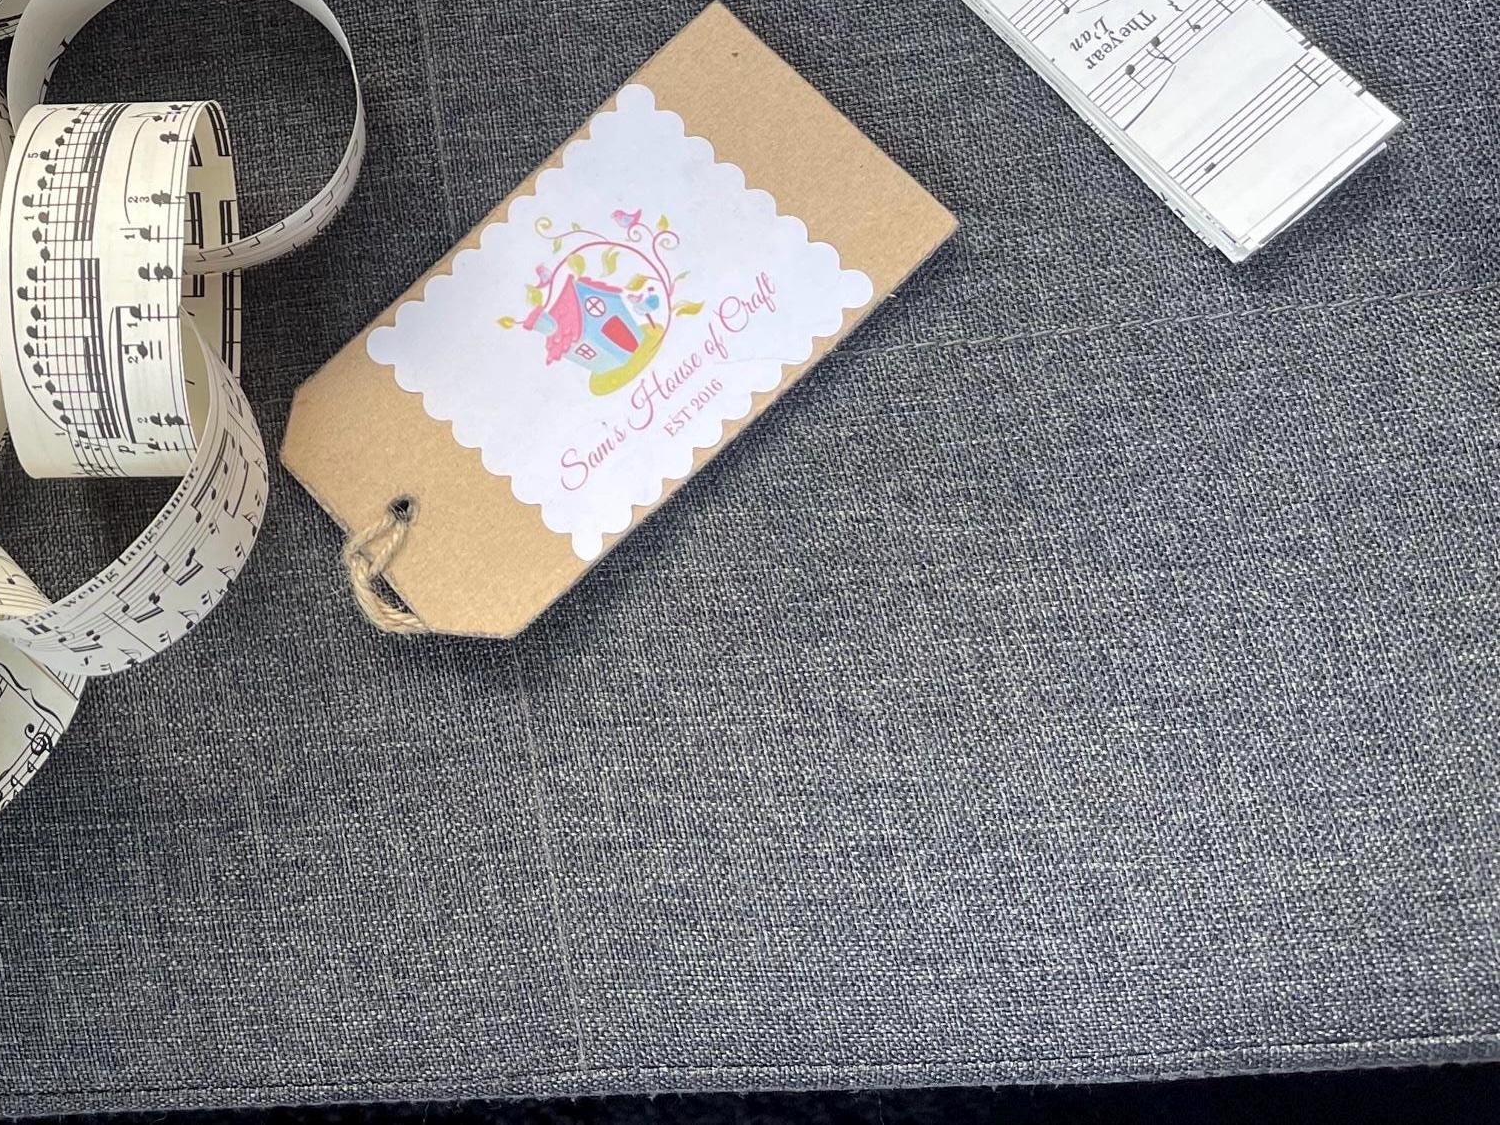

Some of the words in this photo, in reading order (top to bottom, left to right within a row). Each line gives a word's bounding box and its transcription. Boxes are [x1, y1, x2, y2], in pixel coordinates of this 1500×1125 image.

[713, 271, 777, 333] Craft
[704, 322, 729, 360] of
[627, 353, 703, 431] House
[663, 406, 694, 438] EST
[691, 377, 724, 412] 2016
[560, 421, 627, 492] Sam's
